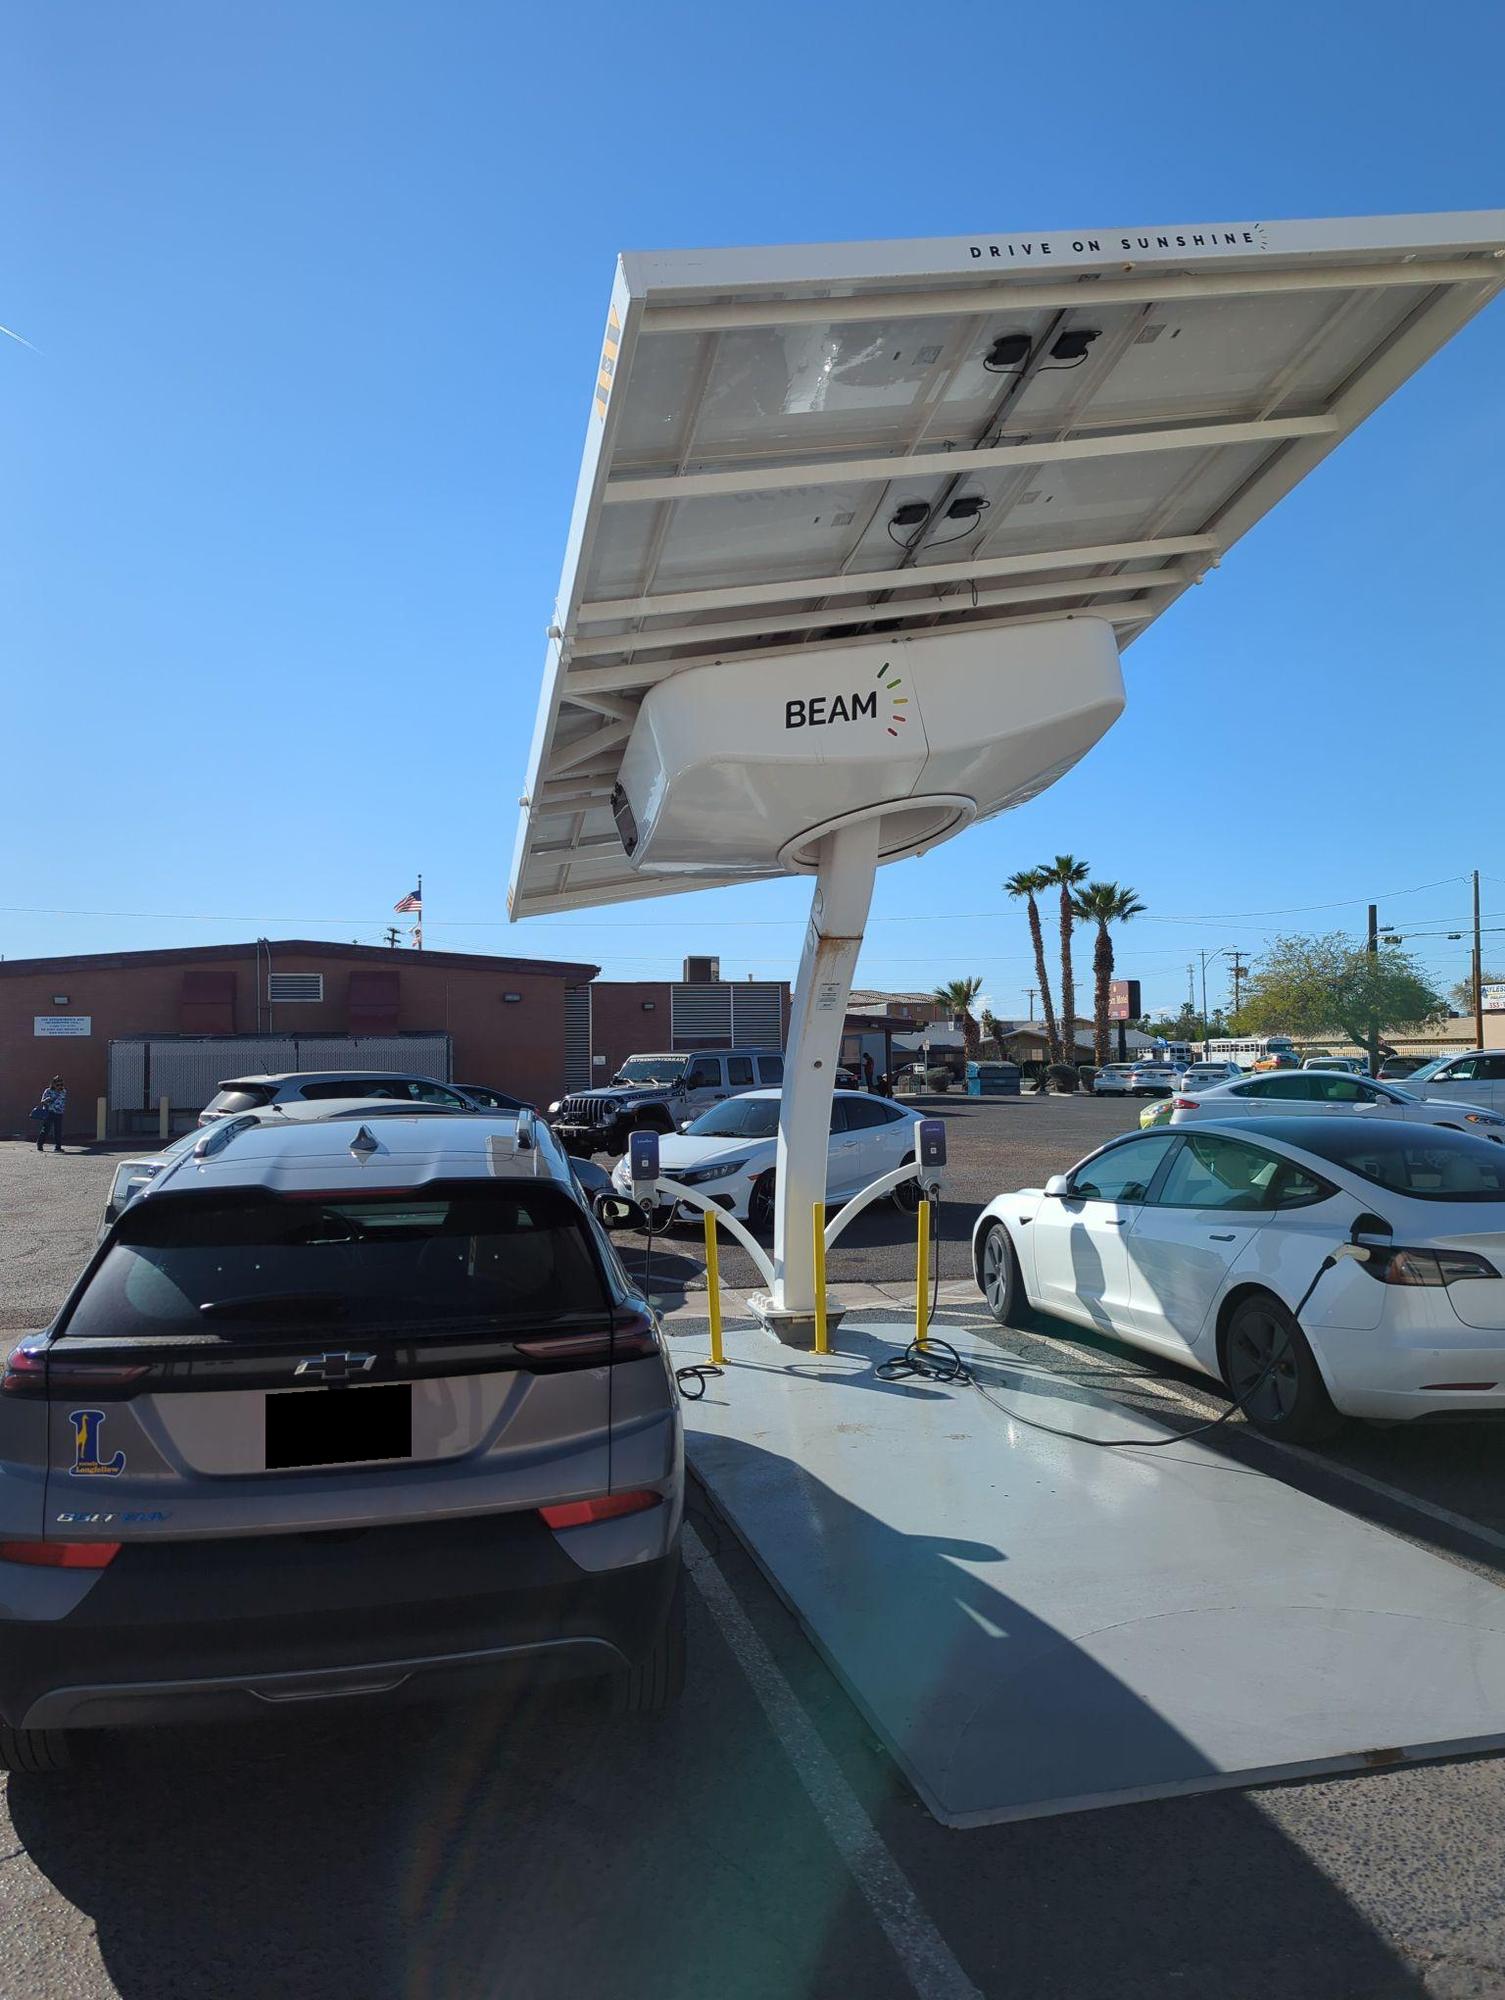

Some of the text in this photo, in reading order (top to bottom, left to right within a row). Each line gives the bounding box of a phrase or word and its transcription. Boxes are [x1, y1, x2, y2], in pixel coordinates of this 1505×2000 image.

[969, 231, 1254, 259] DRIVE ON SUNSHINE
[785, 690, 878, 729] BEAM
